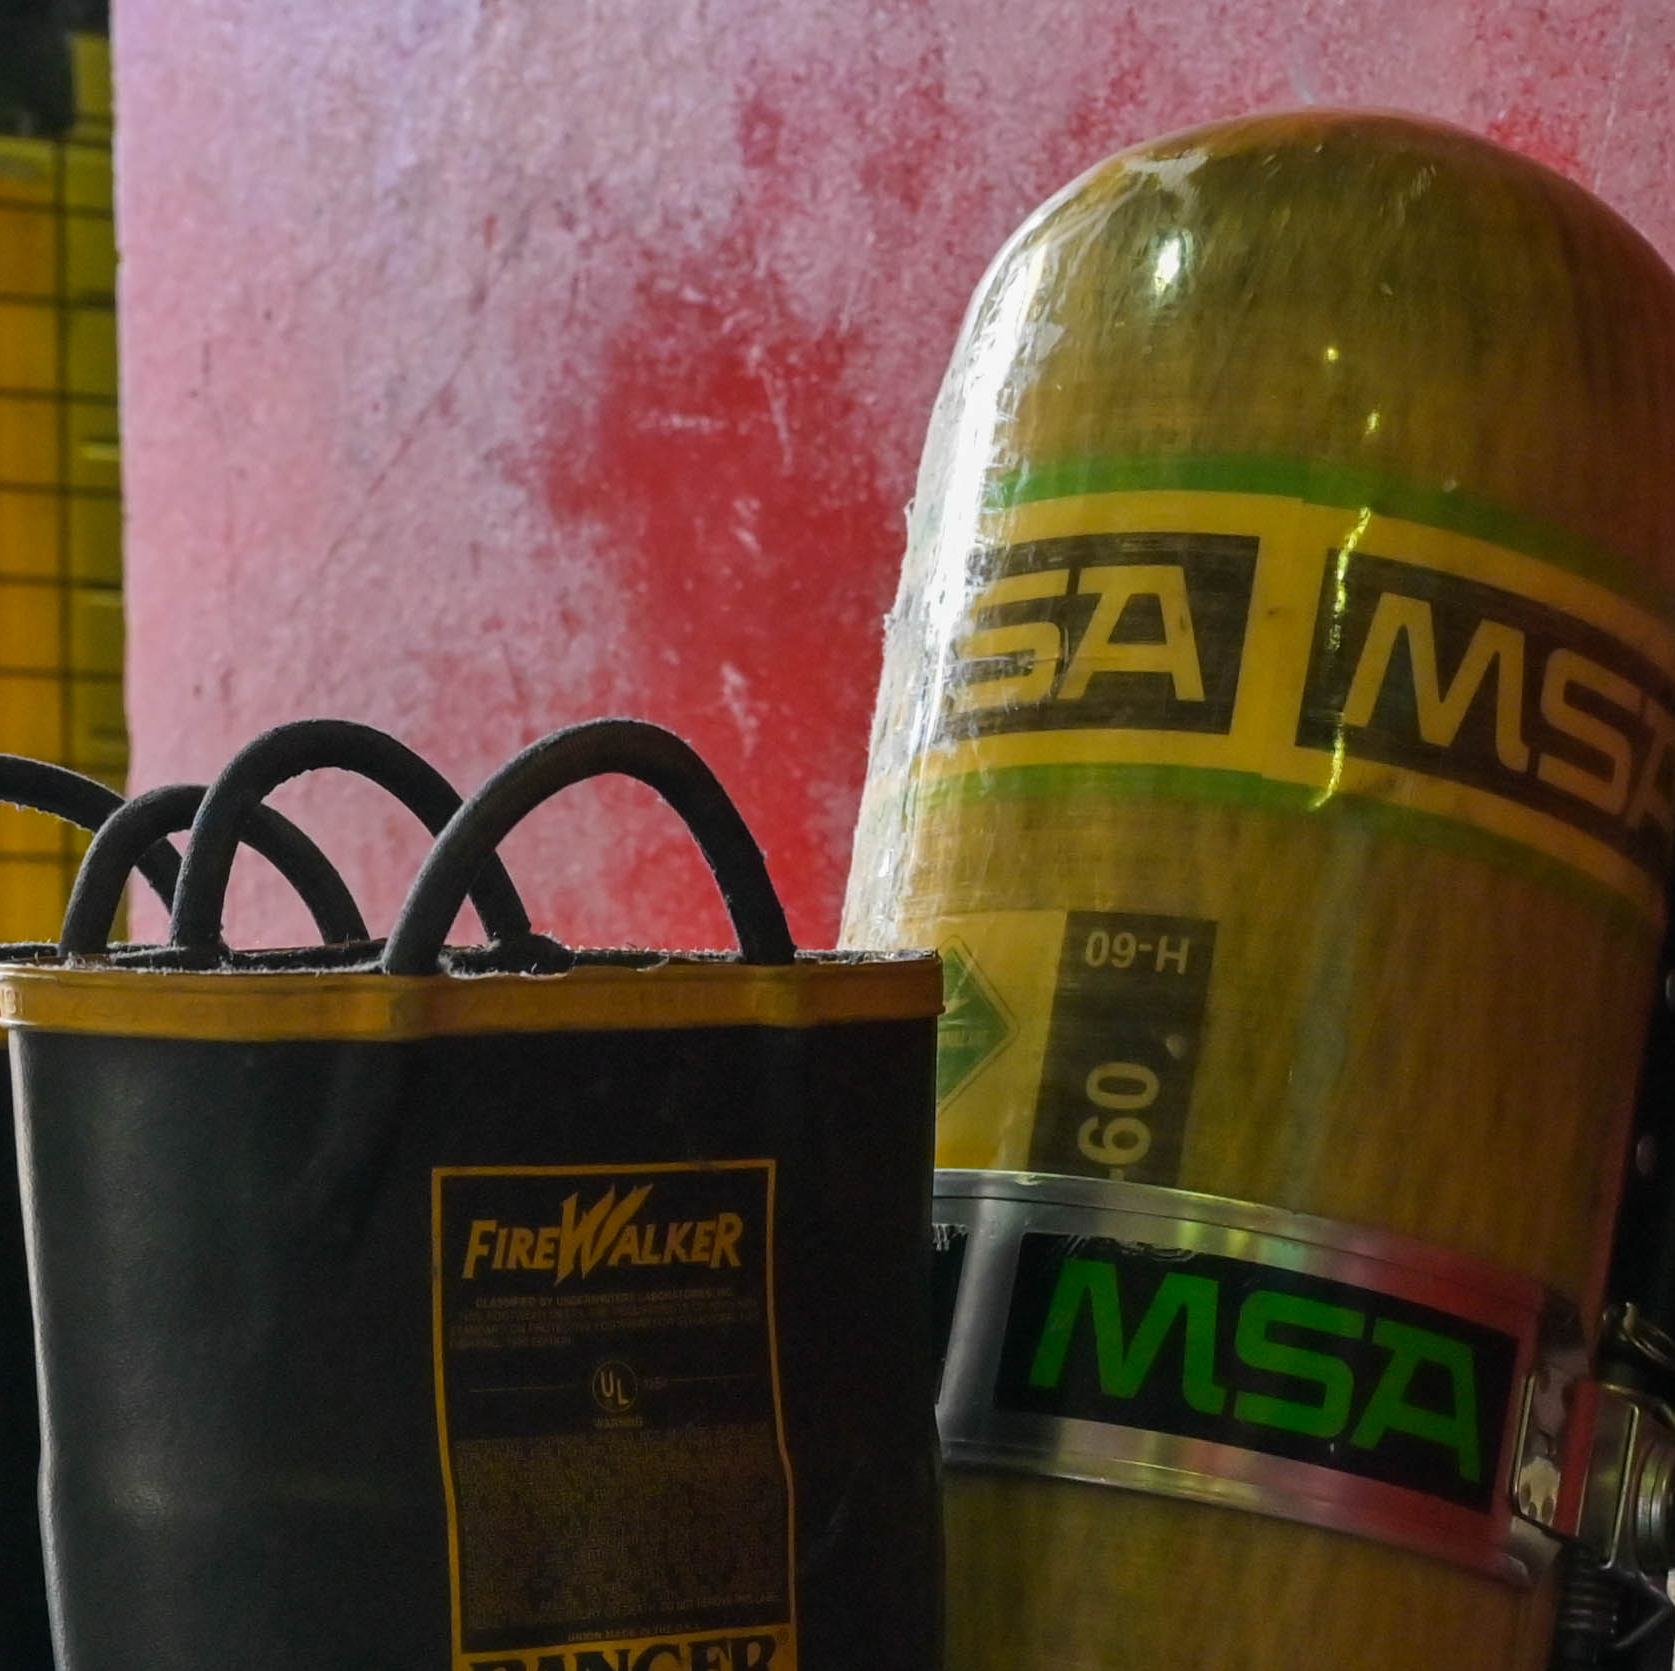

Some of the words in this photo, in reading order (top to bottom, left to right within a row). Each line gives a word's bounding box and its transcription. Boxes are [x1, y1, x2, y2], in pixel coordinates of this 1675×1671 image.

[948, 564, 1206, 711] SA
[461, 1183, 745, 1288] FIREWALKER
[599, 1370, 628, 1406] UL
[1028, 1258, 1481, 1484] MSA
